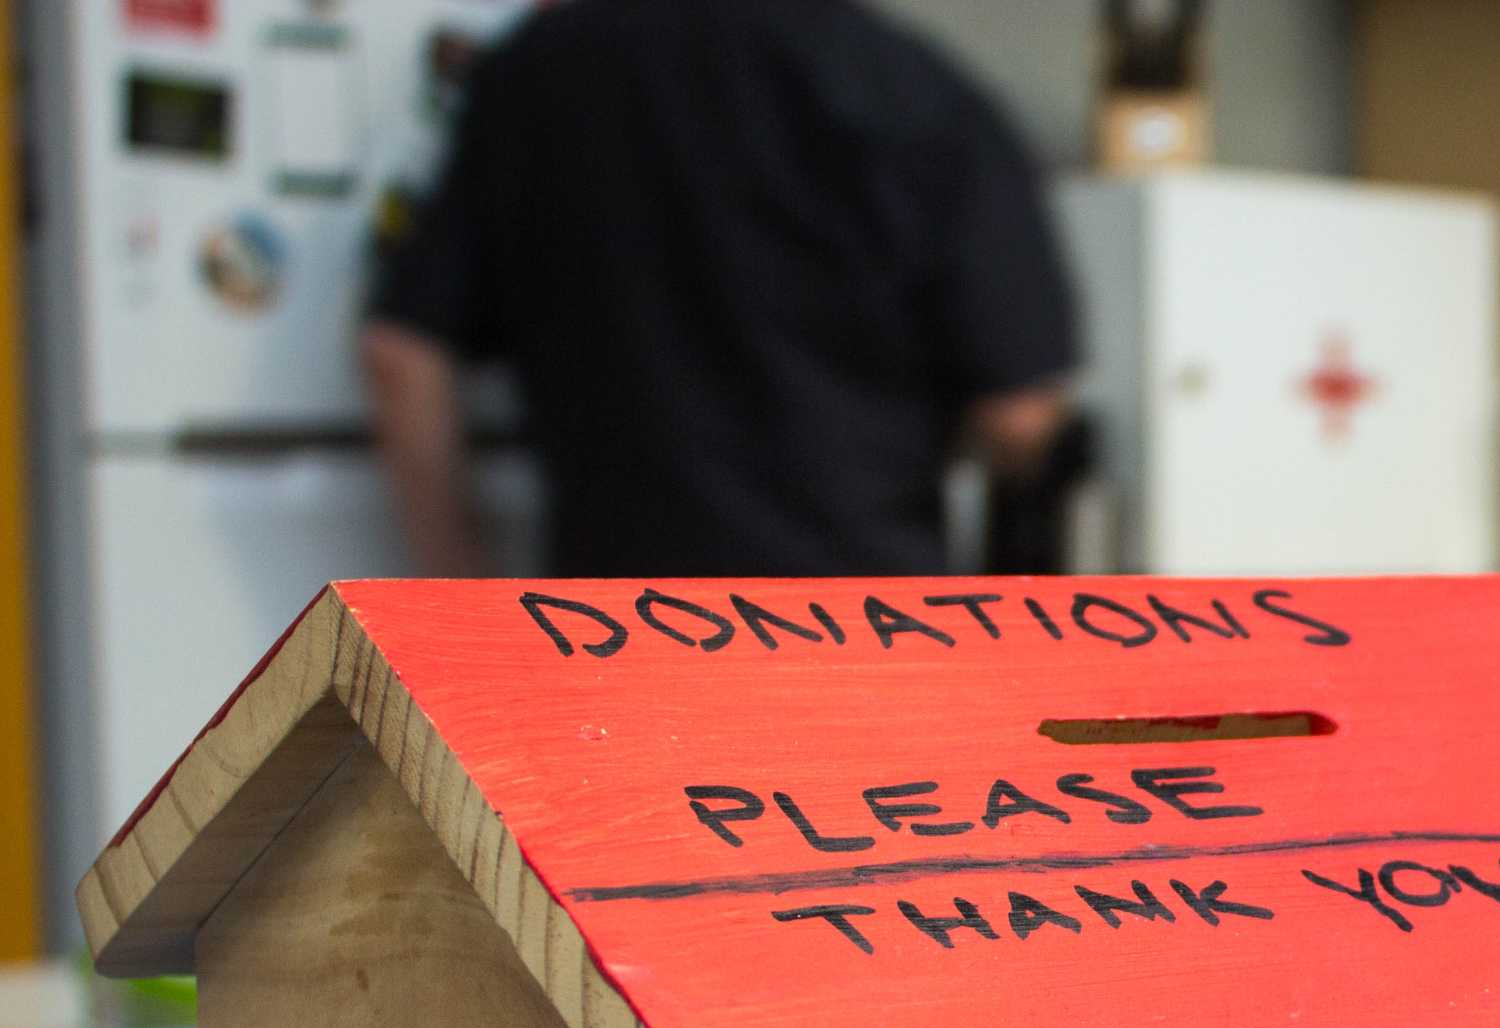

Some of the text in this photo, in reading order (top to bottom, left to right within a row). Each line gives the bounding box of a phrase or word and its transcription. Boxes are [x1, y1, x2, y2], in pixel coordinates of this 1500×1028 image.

[518, 588, 1352, 658] DONATIONS
[682, 766, 1264, 853] PLEASE
[771, 878, 1275, 955] THANK
